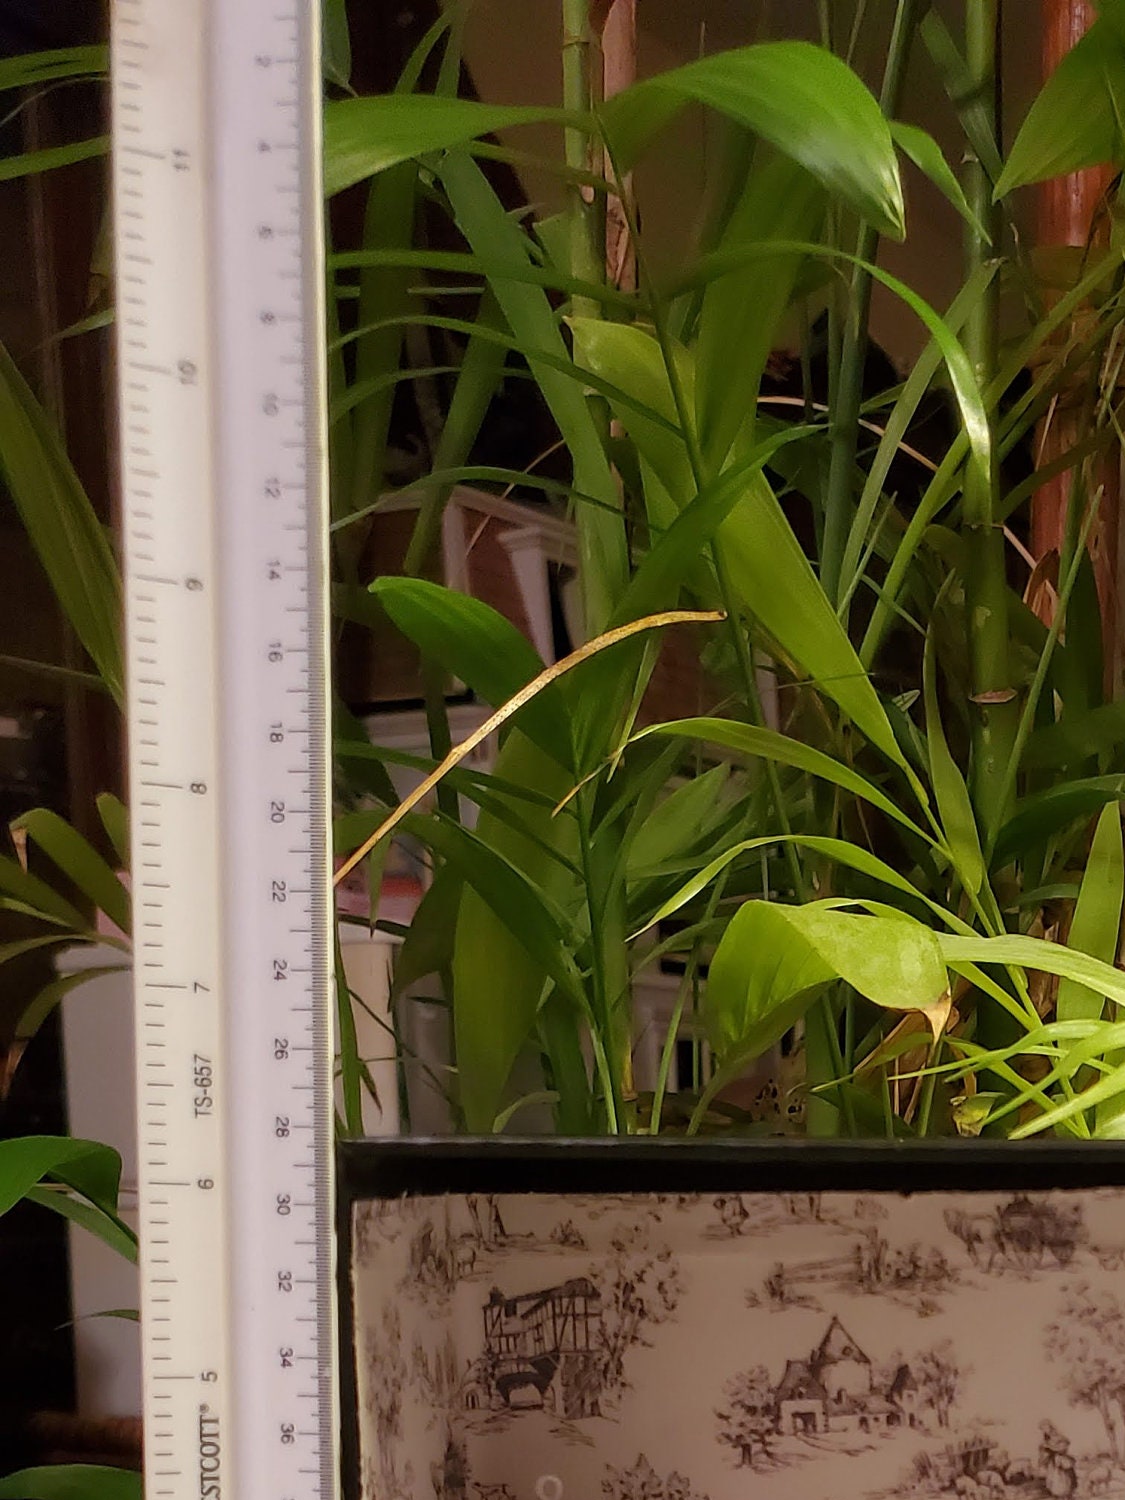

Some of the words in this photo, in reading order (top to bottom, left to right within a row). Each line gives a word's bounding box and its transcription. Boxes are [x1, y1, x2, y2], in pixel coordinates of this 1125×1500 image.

[264, 477, 281, 499] 12
[268, 560, 281, 581] 14
[184, 577, 204, 591] 9
[267, 642, 283, 663] 16
[269, 722, 284, 743] 18
[189, 782, 208, 795] 8
[270, 801, 286, 824] 20
[271, 880, 287, 903] 22
[273, 959, 288, 981] 24
[193, 981, 210, 994] 7
[274, 1038, 289, 1060] 26
[193, 1053, 213, 1118] TS-657
[275, 1116, 290, 1138] 28
[196, 1178, 215, 1190] 6
[276, 1194, 291, 1216] 30
[277, 1271, 293, 1293] 32
[279, 1347, 294, 1369] 34
[200, 1370, 218, 1383] 5
[280, 1423, 295, 1445] 36
